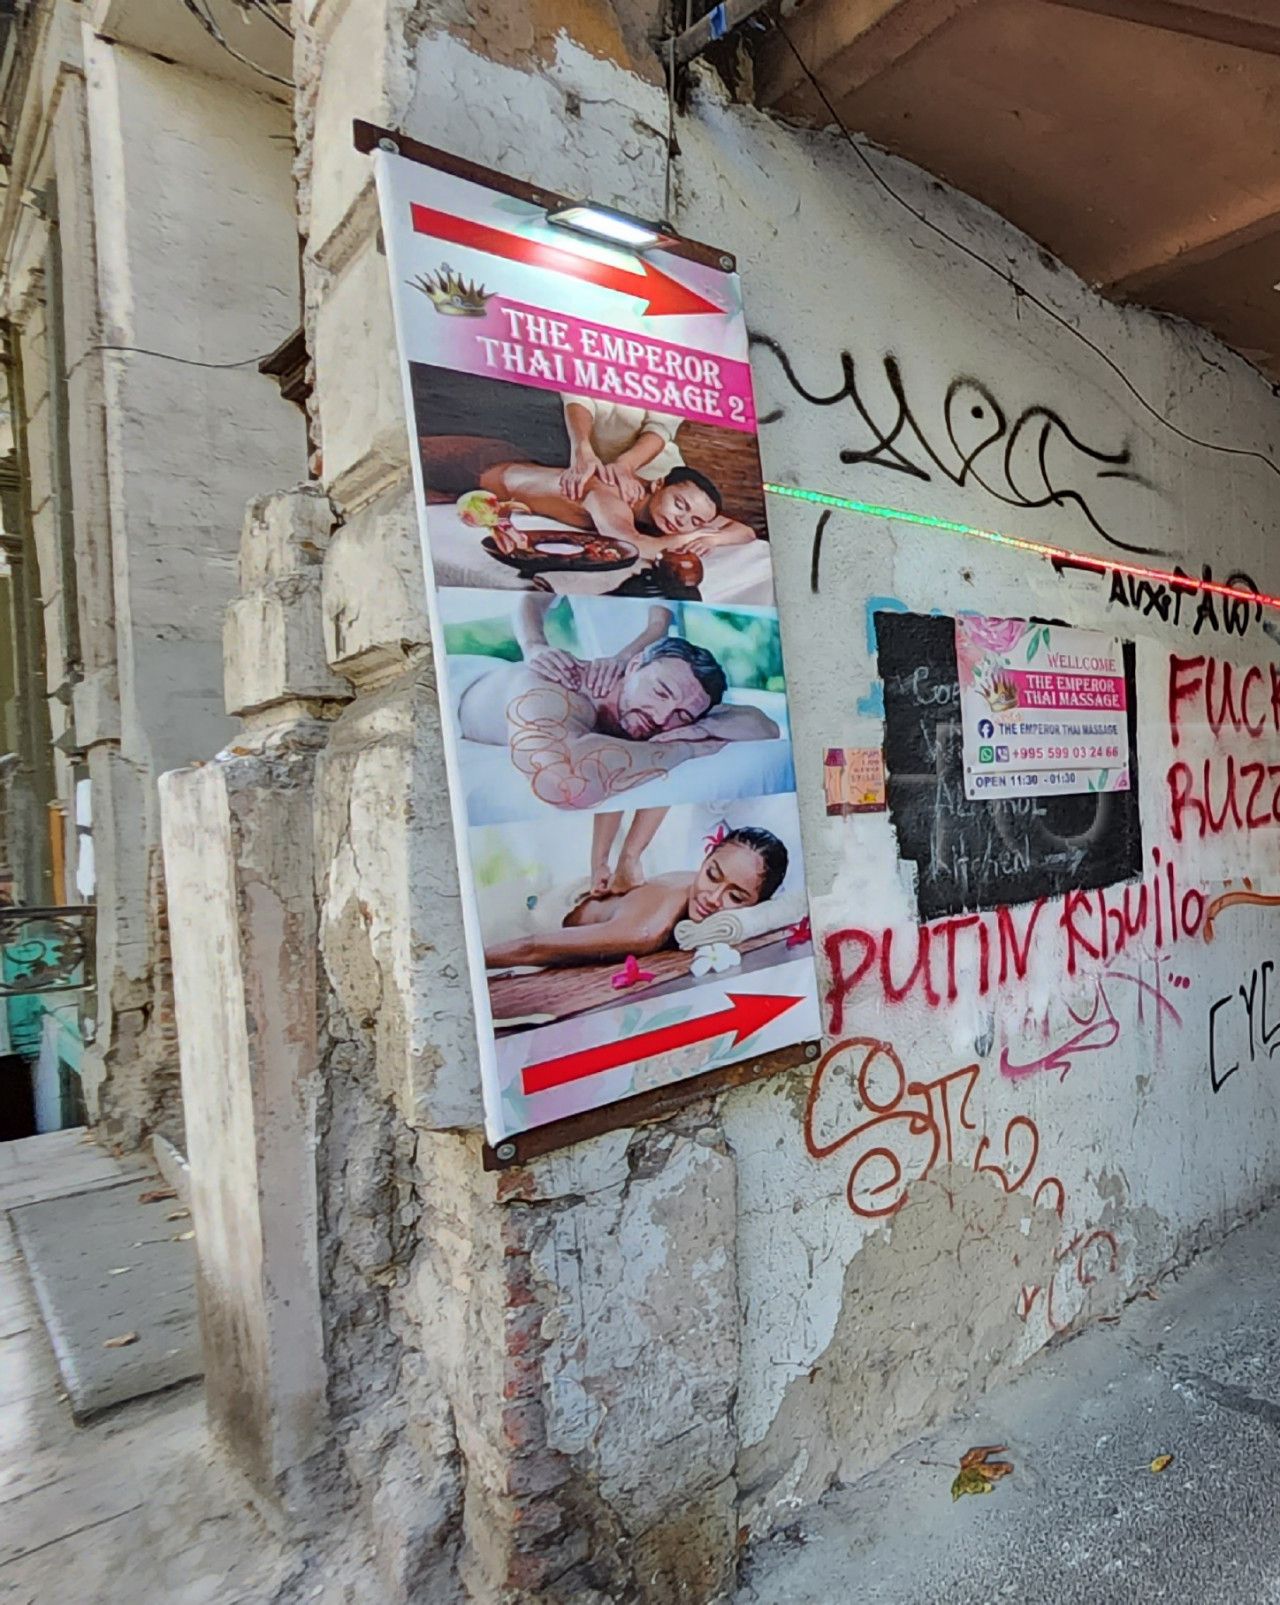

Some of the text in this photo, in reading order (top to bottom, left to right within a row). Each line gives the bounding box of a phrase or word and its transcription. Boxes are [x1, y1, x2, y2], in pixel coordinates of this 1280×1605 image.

[501, 306, 721, 390] THE EMPEROR
[476, 335, 747, 423] THAI MASSAGE 2
[1047, 653, 1117, 673] WELLCOME
[1026, 674, 1115, 692] THE EMPEROR
[1024, 690, 1120, 708] THAI MASSAGE
[999, 722, 1118, 736] THE EMPEROR THAI MASSAGE
[1013, 748, 1044, 760] +995
[1048, 748, 1069, 759] 599
[1073, 748, 1087, 759] 03
[975, 775, 1007, 788] OPEN
[1010, 774, 1038, 787] 11:30
[1049, 772, 1076, 784] 01:30
[824, 894, 1048, 1036] PUTIN
